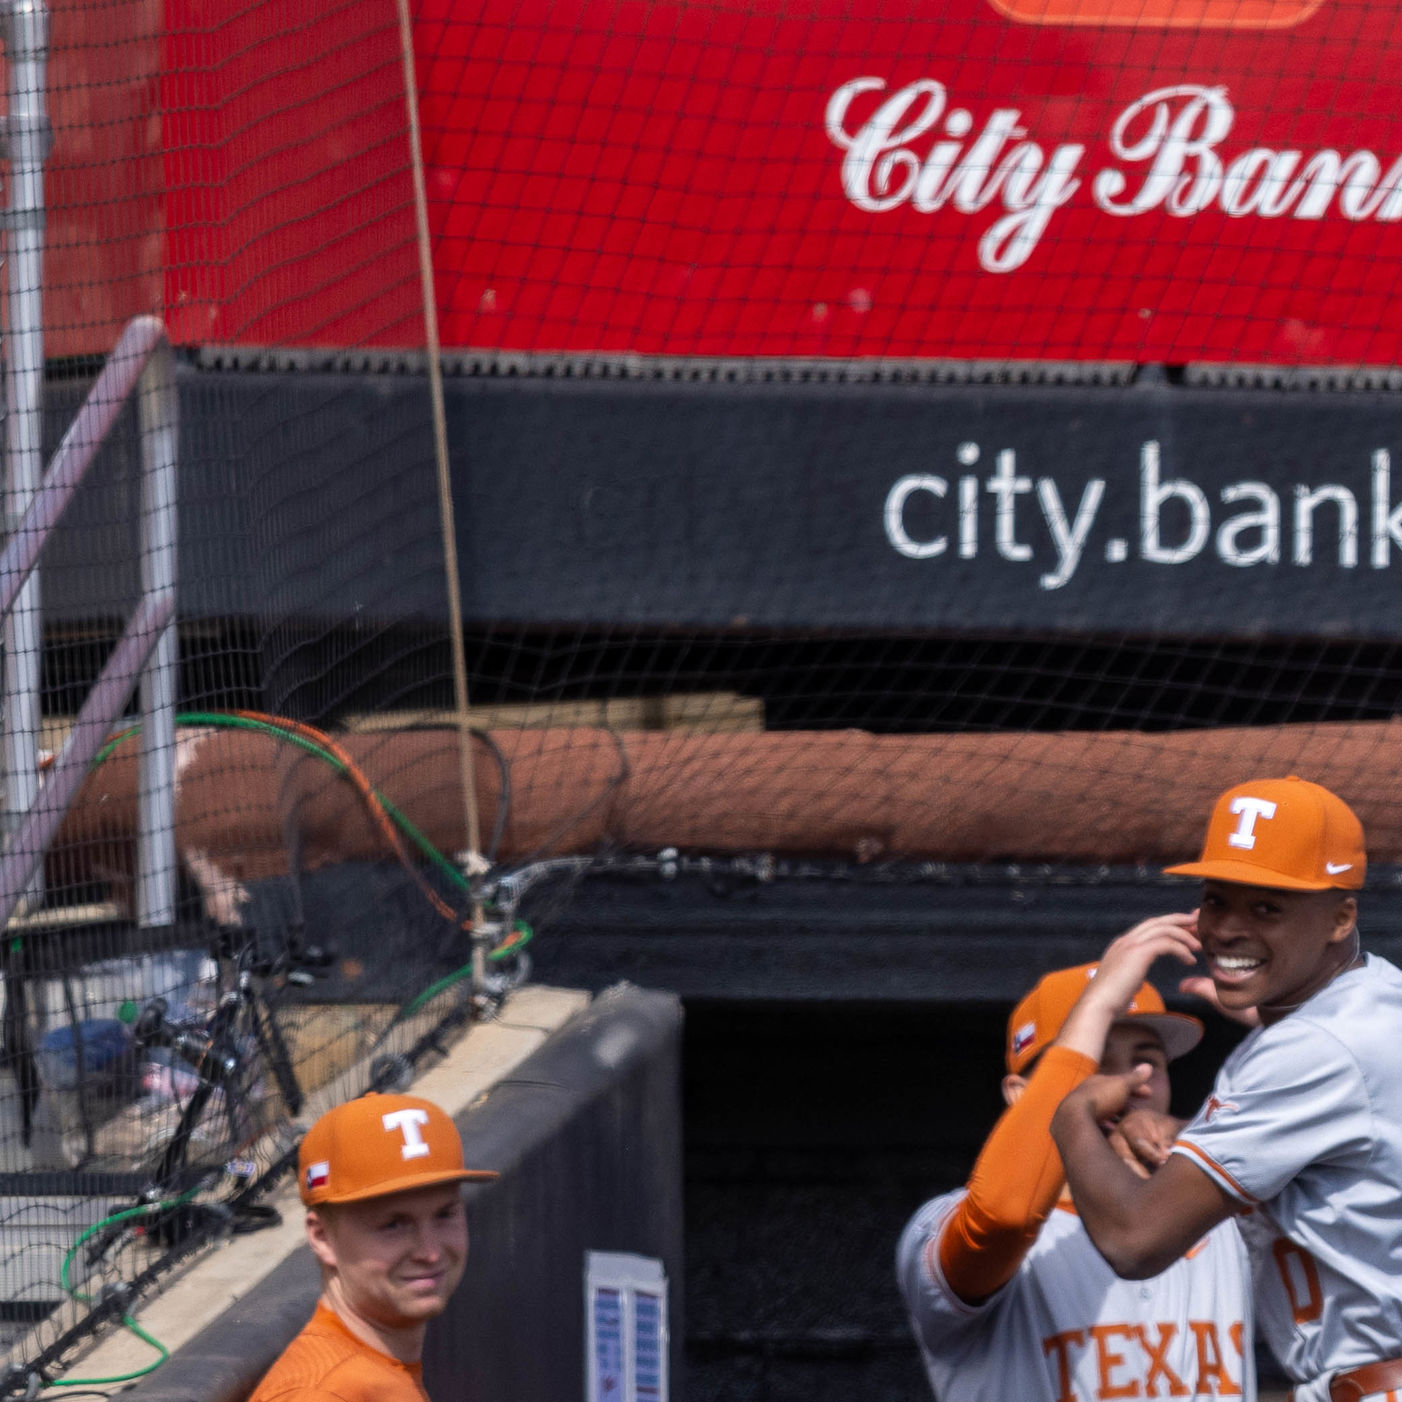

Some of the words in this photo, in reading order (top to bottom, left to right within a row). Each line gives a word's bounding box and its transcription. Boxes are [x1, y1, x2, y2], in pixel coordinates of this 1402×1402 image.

[825, 76, 1085, 273] City
[1228, 797, 1277, 849] T
[382, 1108, 430, 1160] T
